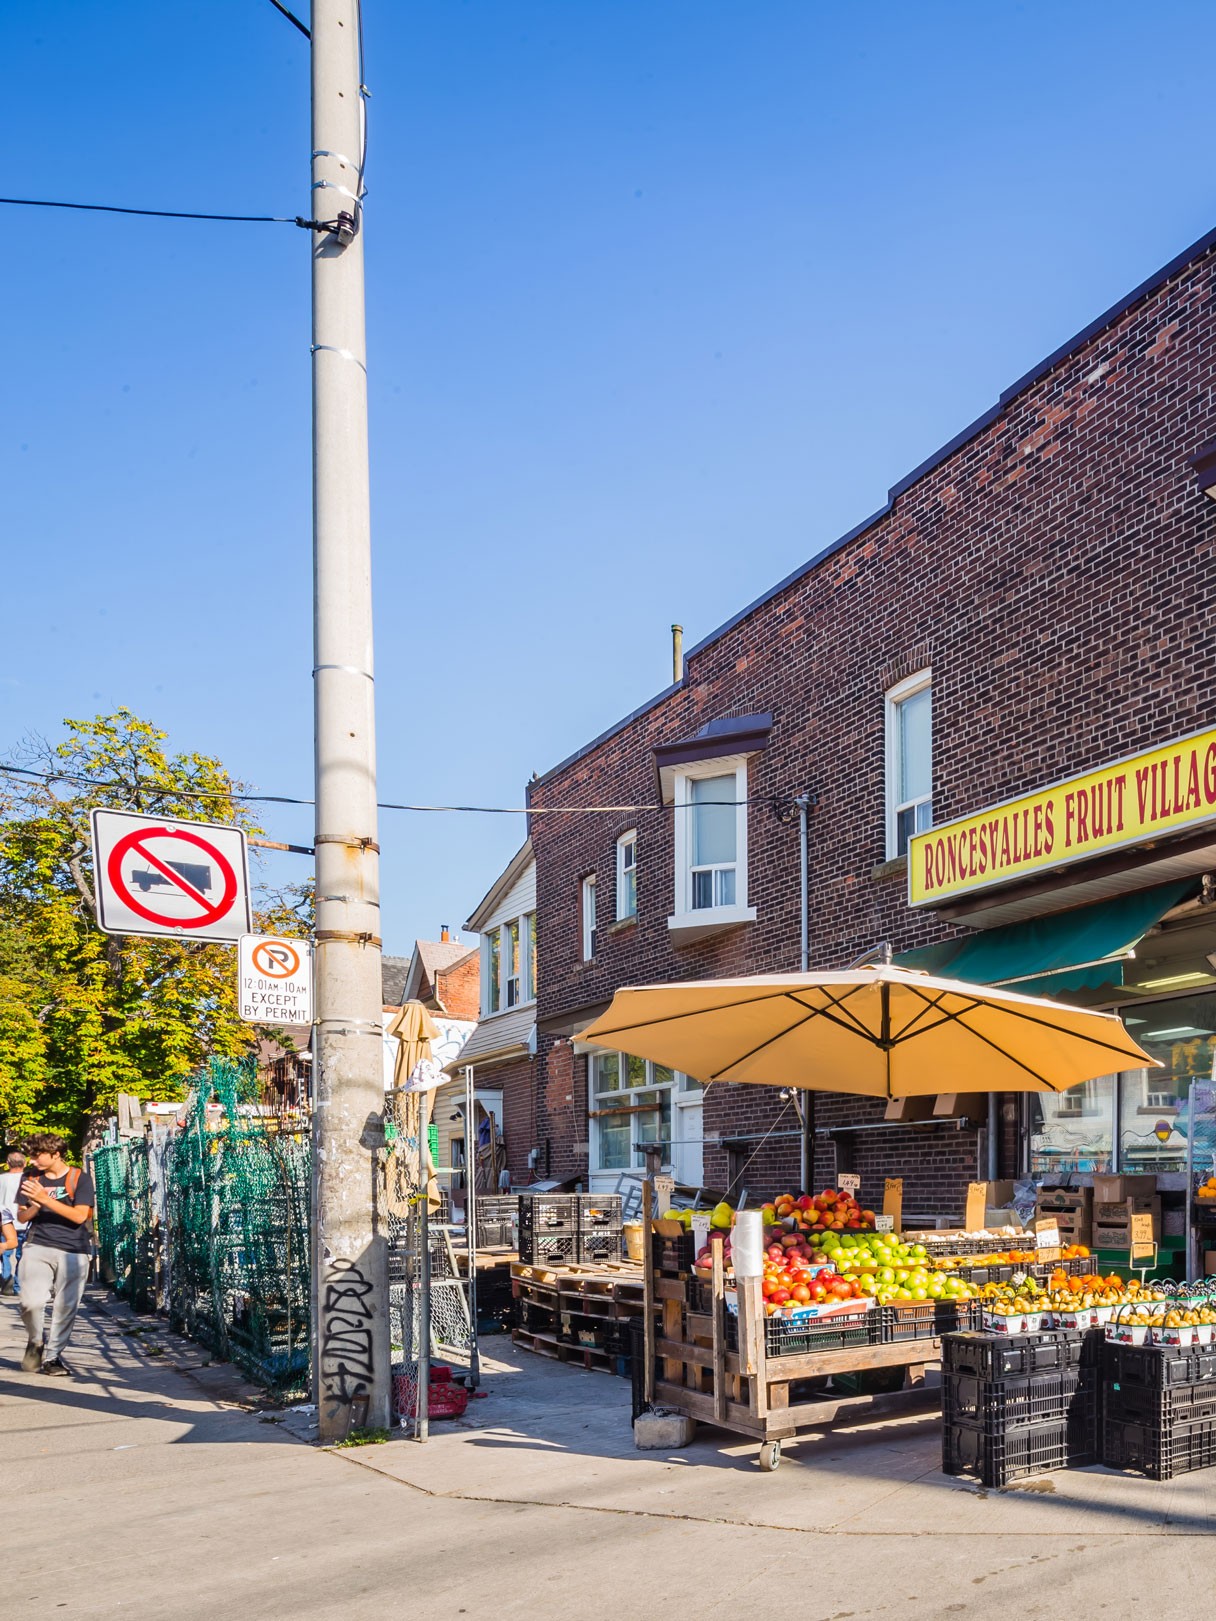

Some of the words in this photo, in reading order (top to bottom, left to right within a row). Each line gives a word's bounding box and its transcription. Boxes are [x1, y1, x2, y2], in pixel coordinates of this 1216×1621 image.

[924, 800, 1055, 890] RONCESVALLES
[1065, 774, 1127, 847] FRUIT
[251, 992, 298, 1006] EXCEPT
[244, 1005, 259, 1016] BY
[265, 1007, 307, 1020] PERMIT
